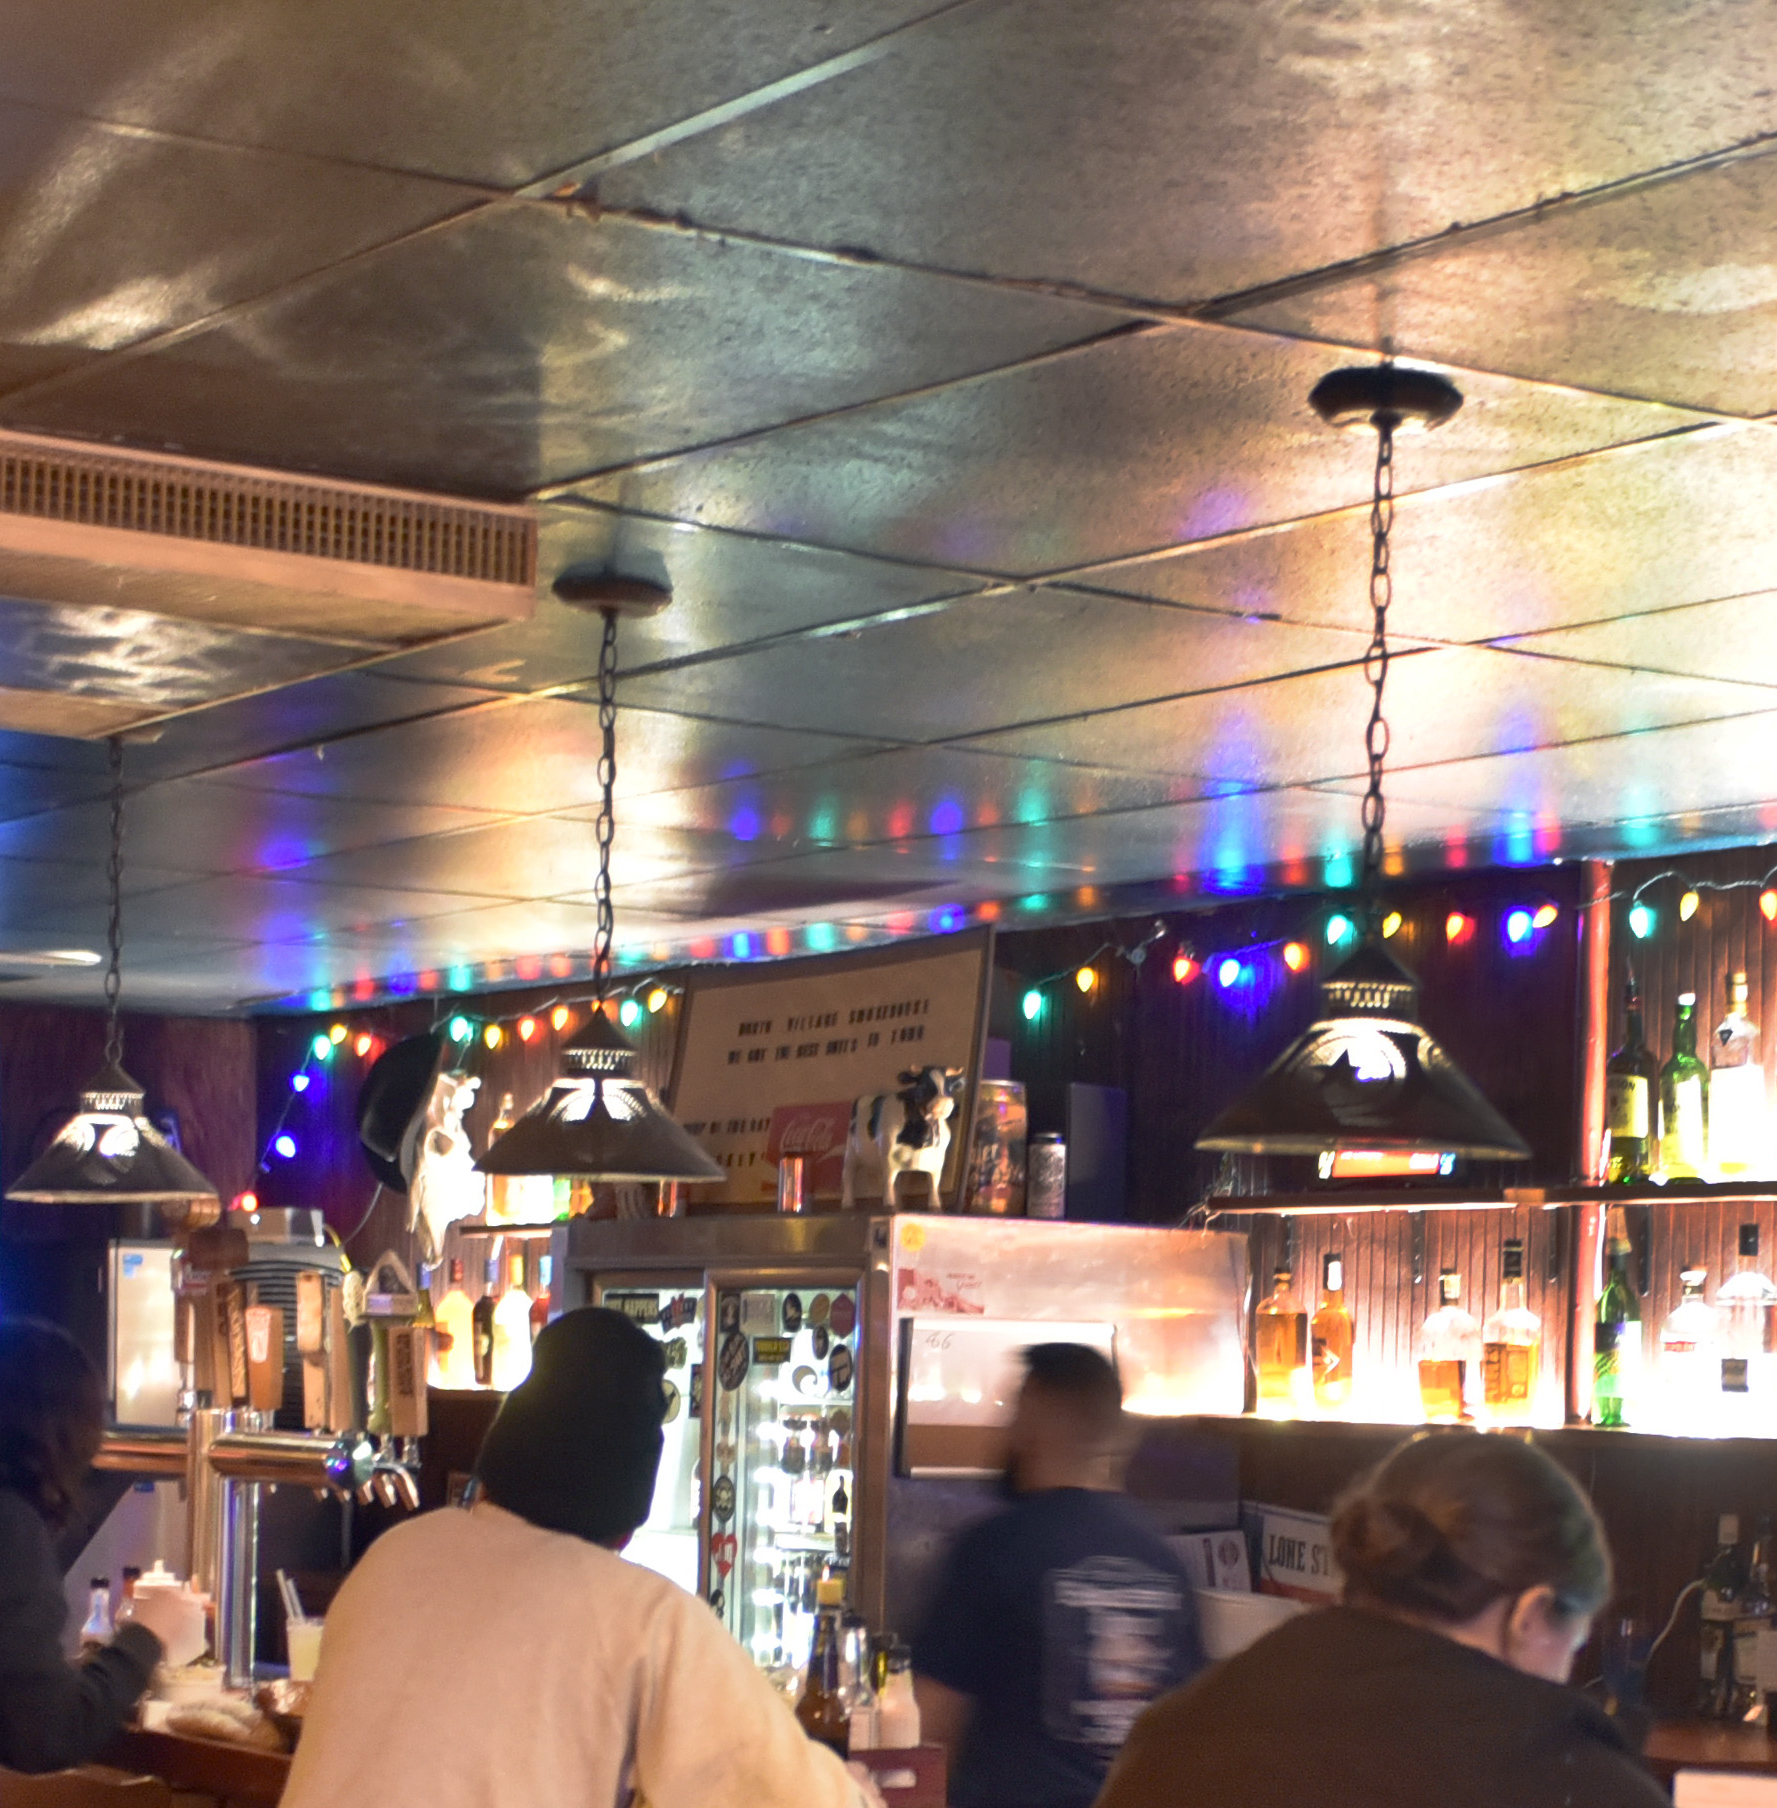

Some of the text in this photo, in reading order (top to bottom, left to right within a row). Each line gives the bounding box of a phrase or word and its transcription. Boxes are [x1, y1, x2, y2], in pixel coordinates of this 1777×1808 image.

[787, 1011, 839, 1032] VILLAGE
[848, 998, 930, 1025] SMOKEHOUSE
[1268, 1535, 1306, 1572] LONE
